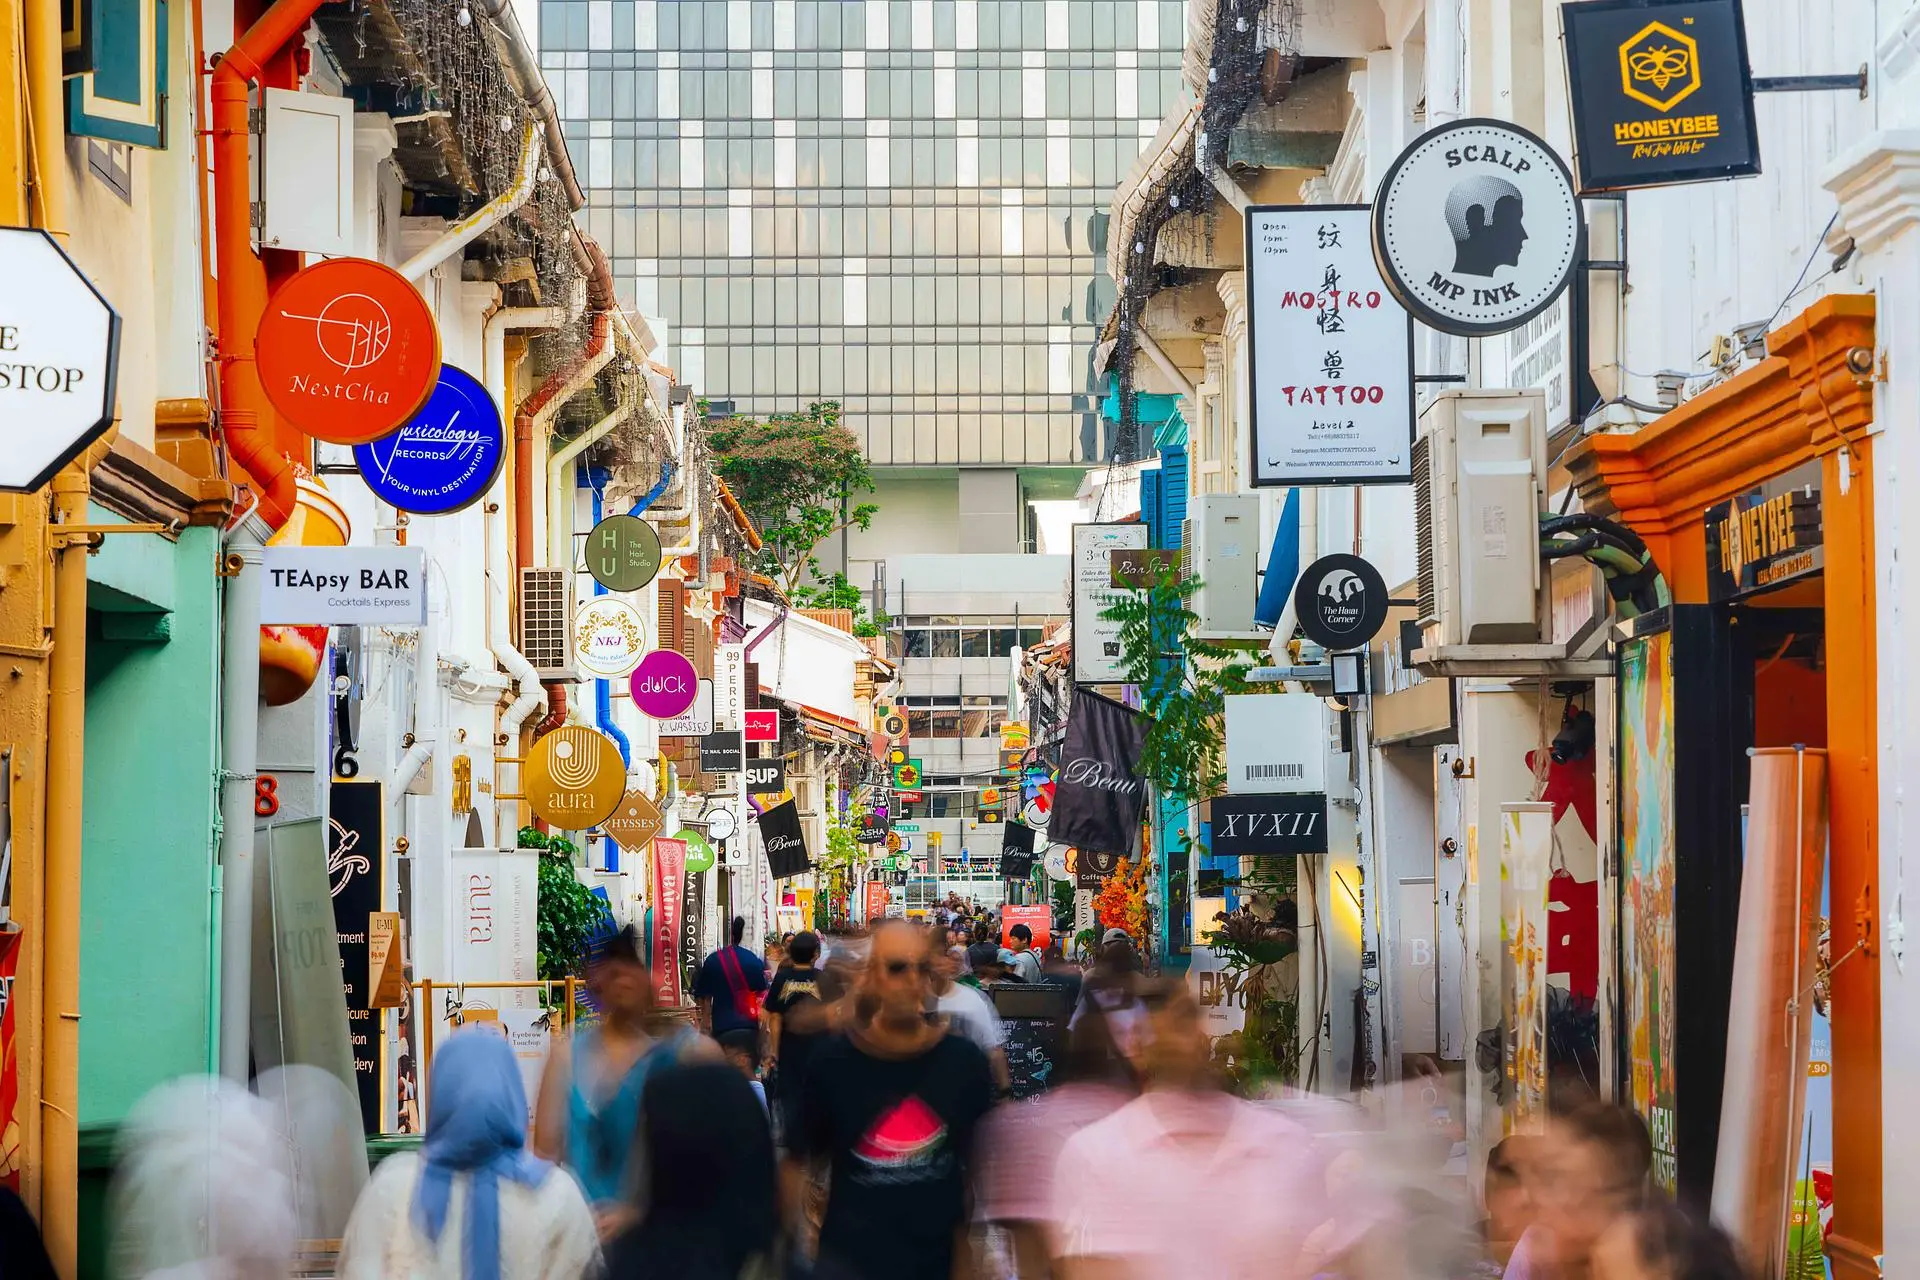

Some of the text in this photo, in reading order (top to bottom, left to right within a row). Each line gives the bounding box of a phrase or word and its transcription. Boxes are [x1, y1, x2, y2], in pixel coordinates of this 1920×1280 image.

[1614, 115, 1719, 140] HONEYBEE
[1445, 145, 1531, 174] SCALP
[1427, 271, 1521, 306] MP INK
[1281, 290, 1381, 309] MOSTRO
[0, 362, 84, 394] STOP
[1282, 385, 1384, 406] TATTOO
[1312, 420, 1355, 429] Level 2
[395, 449, 446, 460] RECORDS
[387, 445, 485, 496] YOUR VINYL DESTINATION
[629, 540, 642, 549] The
[629, 550, 645, 558] Hair
[629, 559, 651, 567] Studio
[270, 569, 410, 592] TEApsy BAR
[328, 597, 411, 607] Cocktails Express
[1324, 606, 1338, 614] The
[1327, 615, 1356, 623] Corner
[726, 651, 740, 661] 99
[334, 746, 359, 778] 6
[1064, 757, 1138, 794] Beau
[255, 775, 280, 817] 8
[548, 792, 595, 809] aura
[611, 818, 655, 829] HYSSES
[1217, 812, 1320, 838] XVXII
[767, 835, 802, 852] Beau
[880, 857, 893, 866] EXIT
[469, 874, 493, 945] aura
[686, 872, 697, 972] NAIL SOCIAL
[512, 1030, 542, 1039] Eyebrow
[512, 1039, 542, 1047] Touchup
[1651, 1106, 1676, 1154] REAL
[1652, 1150, 1676, 1192] TASTE
